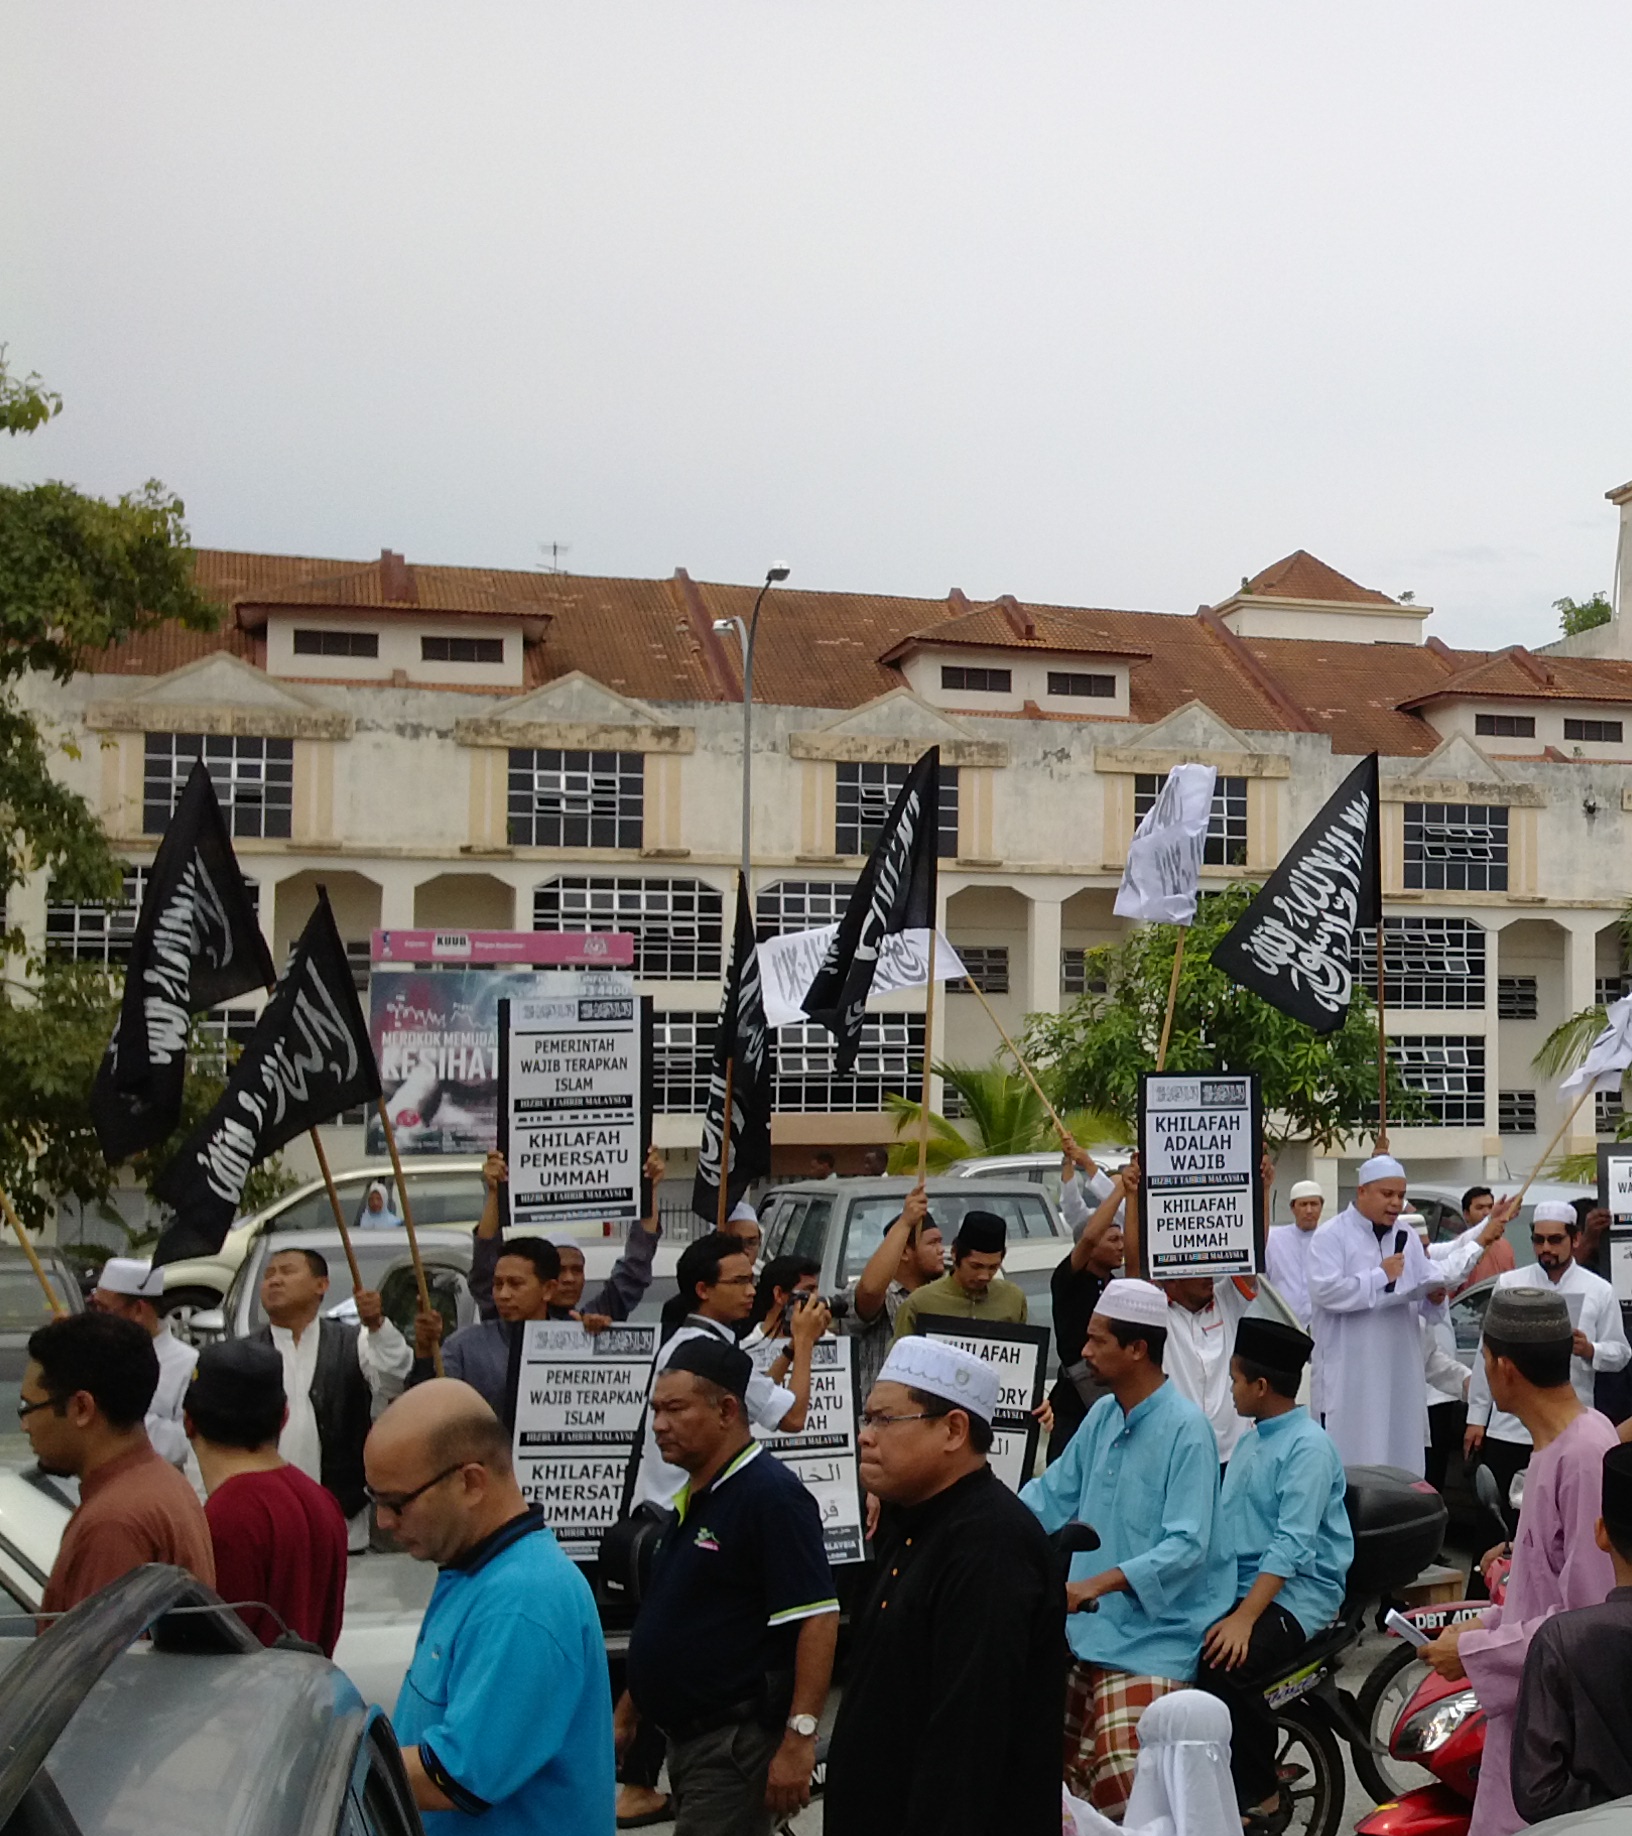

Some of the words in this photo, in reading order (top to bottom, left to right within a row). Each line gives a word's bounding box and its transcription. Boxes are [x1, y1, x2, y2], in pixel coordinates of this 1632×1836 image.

[382, 1031, 441, 1048] MEROKOK
[535, 1038, 615, 1054] PEMERINTAH
[520, 1059, 560, 1074] WAJIB
[565, 1057, 628, 1072] TERAPKAN
[555, 1077, 593, 1092] ISLAM
[1155, 1115, 1240, 1132] KHILAFAH
[529, 1130, 620, 1148] KHILAFAH
[1164, 1134, 1232, 1151] ADALAH
[520, 1149, 629, 1168] PEMERSATU
[1170, 1154, 1226, 1171] WAJIB
[540, 1170, 609, 1187] UMMAH
[1163, 1196, 1236, 1213] KHILAFAH
[1157, 1214, 1243, 1232] PEMERSATU
[1173, 1232, 1228, 1248] UMMAH
[546, 1369, 631, 1384] PEMERINTAH
[530, 1390, 572, 1405] WAJIB
[576, 1390, 643, 1405] TERAPKAN
[564, 1410, 605, 1425] ISLAM
[595, 1431, 634, 1442] MALAYSI
[522, 1484, 624, 1500] PEMERSAT
[824, 1540, 857, 1551] ALAYSIA
[1415, 1611, 1447, 1629] DBT
